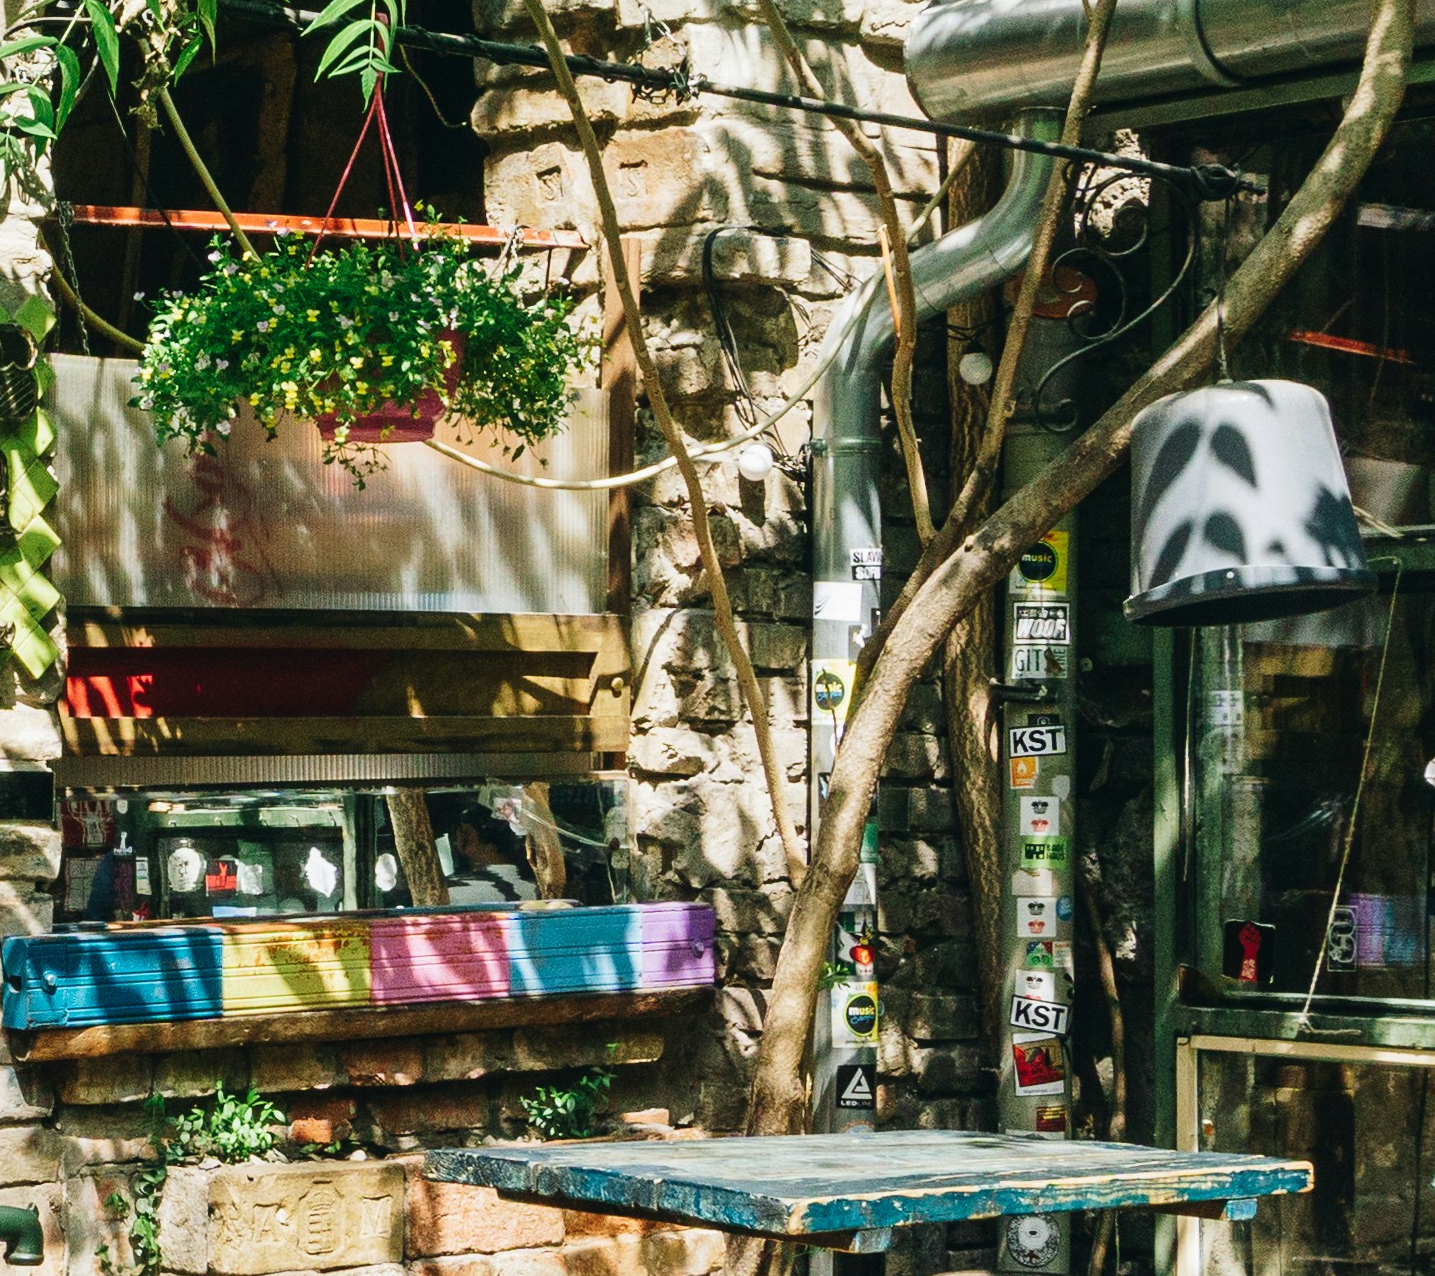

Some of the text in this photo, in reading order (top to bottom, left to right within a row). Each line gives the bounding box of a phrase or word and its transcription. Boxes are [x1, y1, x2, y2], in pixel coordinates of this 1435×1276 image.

[1021, 553, 1054, 564] music
[1011, 727, 1064, 755] KST
[1013, 999, 1066, 1031] KST
